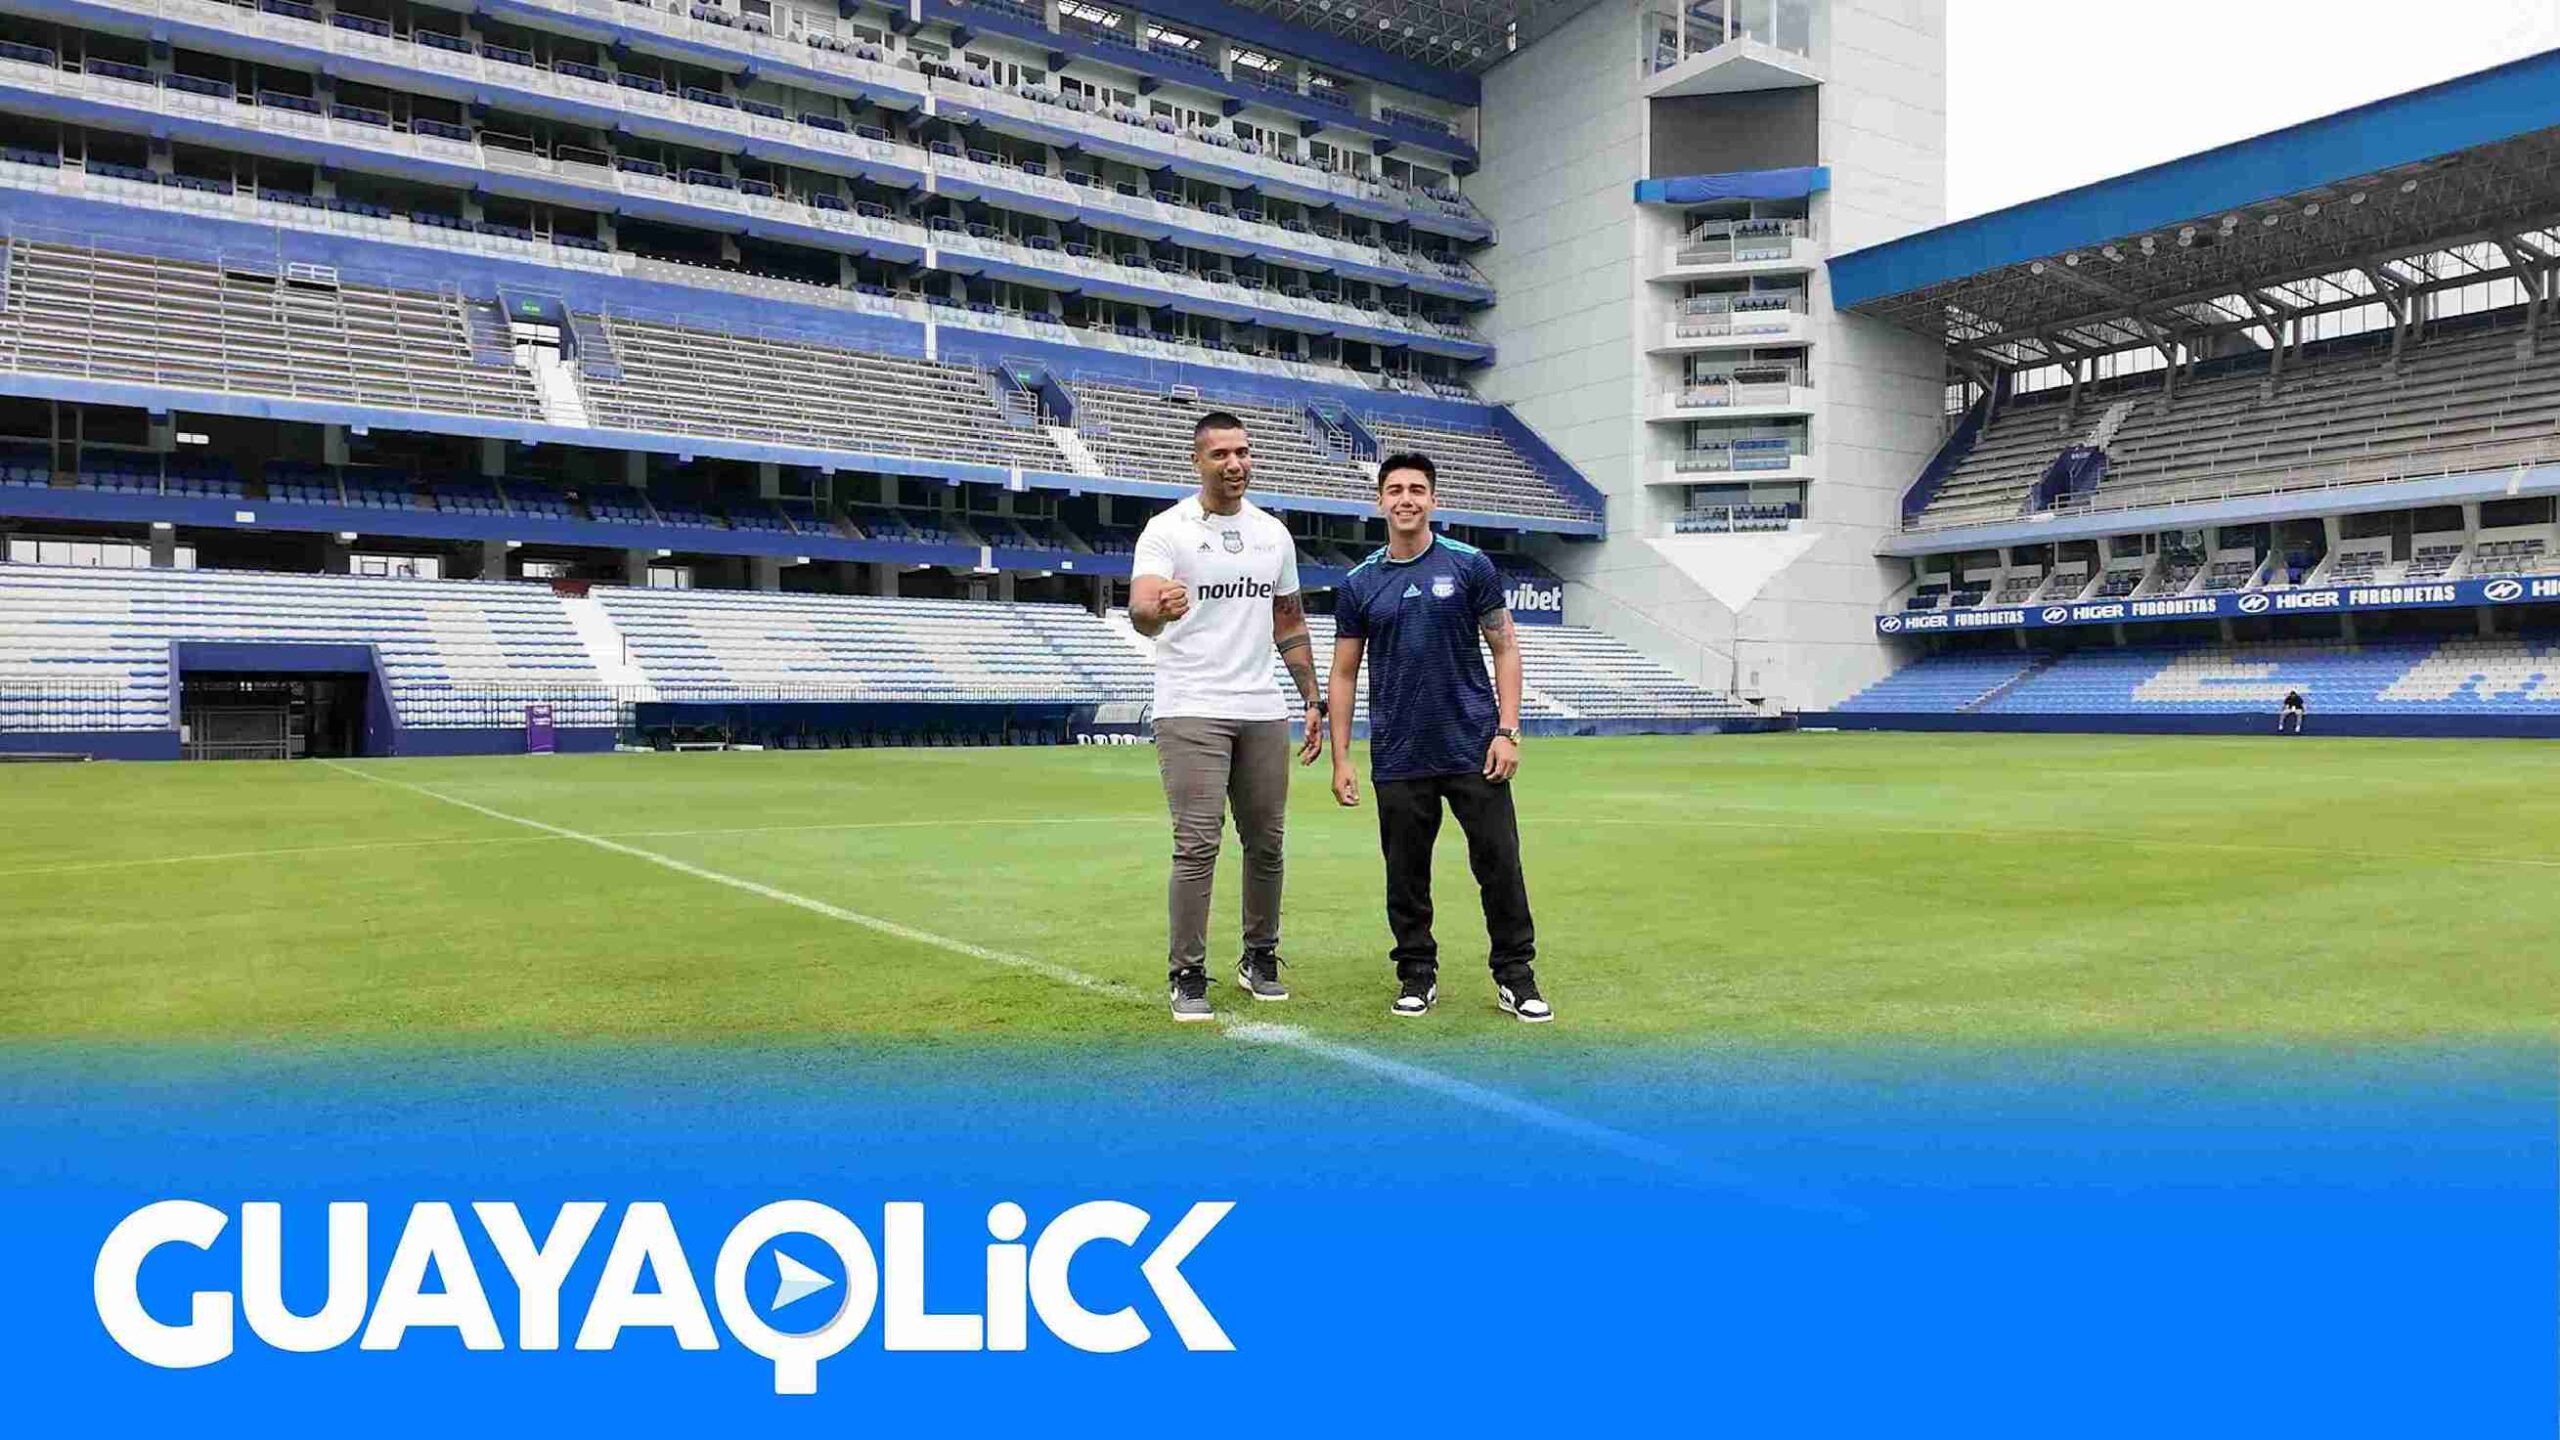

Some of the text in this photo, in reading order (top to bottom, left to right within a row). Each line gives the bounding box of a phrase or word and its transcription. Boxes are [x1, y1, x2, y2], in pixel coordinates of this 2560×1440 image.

[1503, 583, 1562, 612] vibet
[2276, 585, 2456, 609] HIGER FURGONETAS
[2531, 579, 2560, 597] HI
[1905, 610, 2026, 630] HIGER FURGONETAS
[2072, 598, 2217, 621] HIGER FURGONETAS
